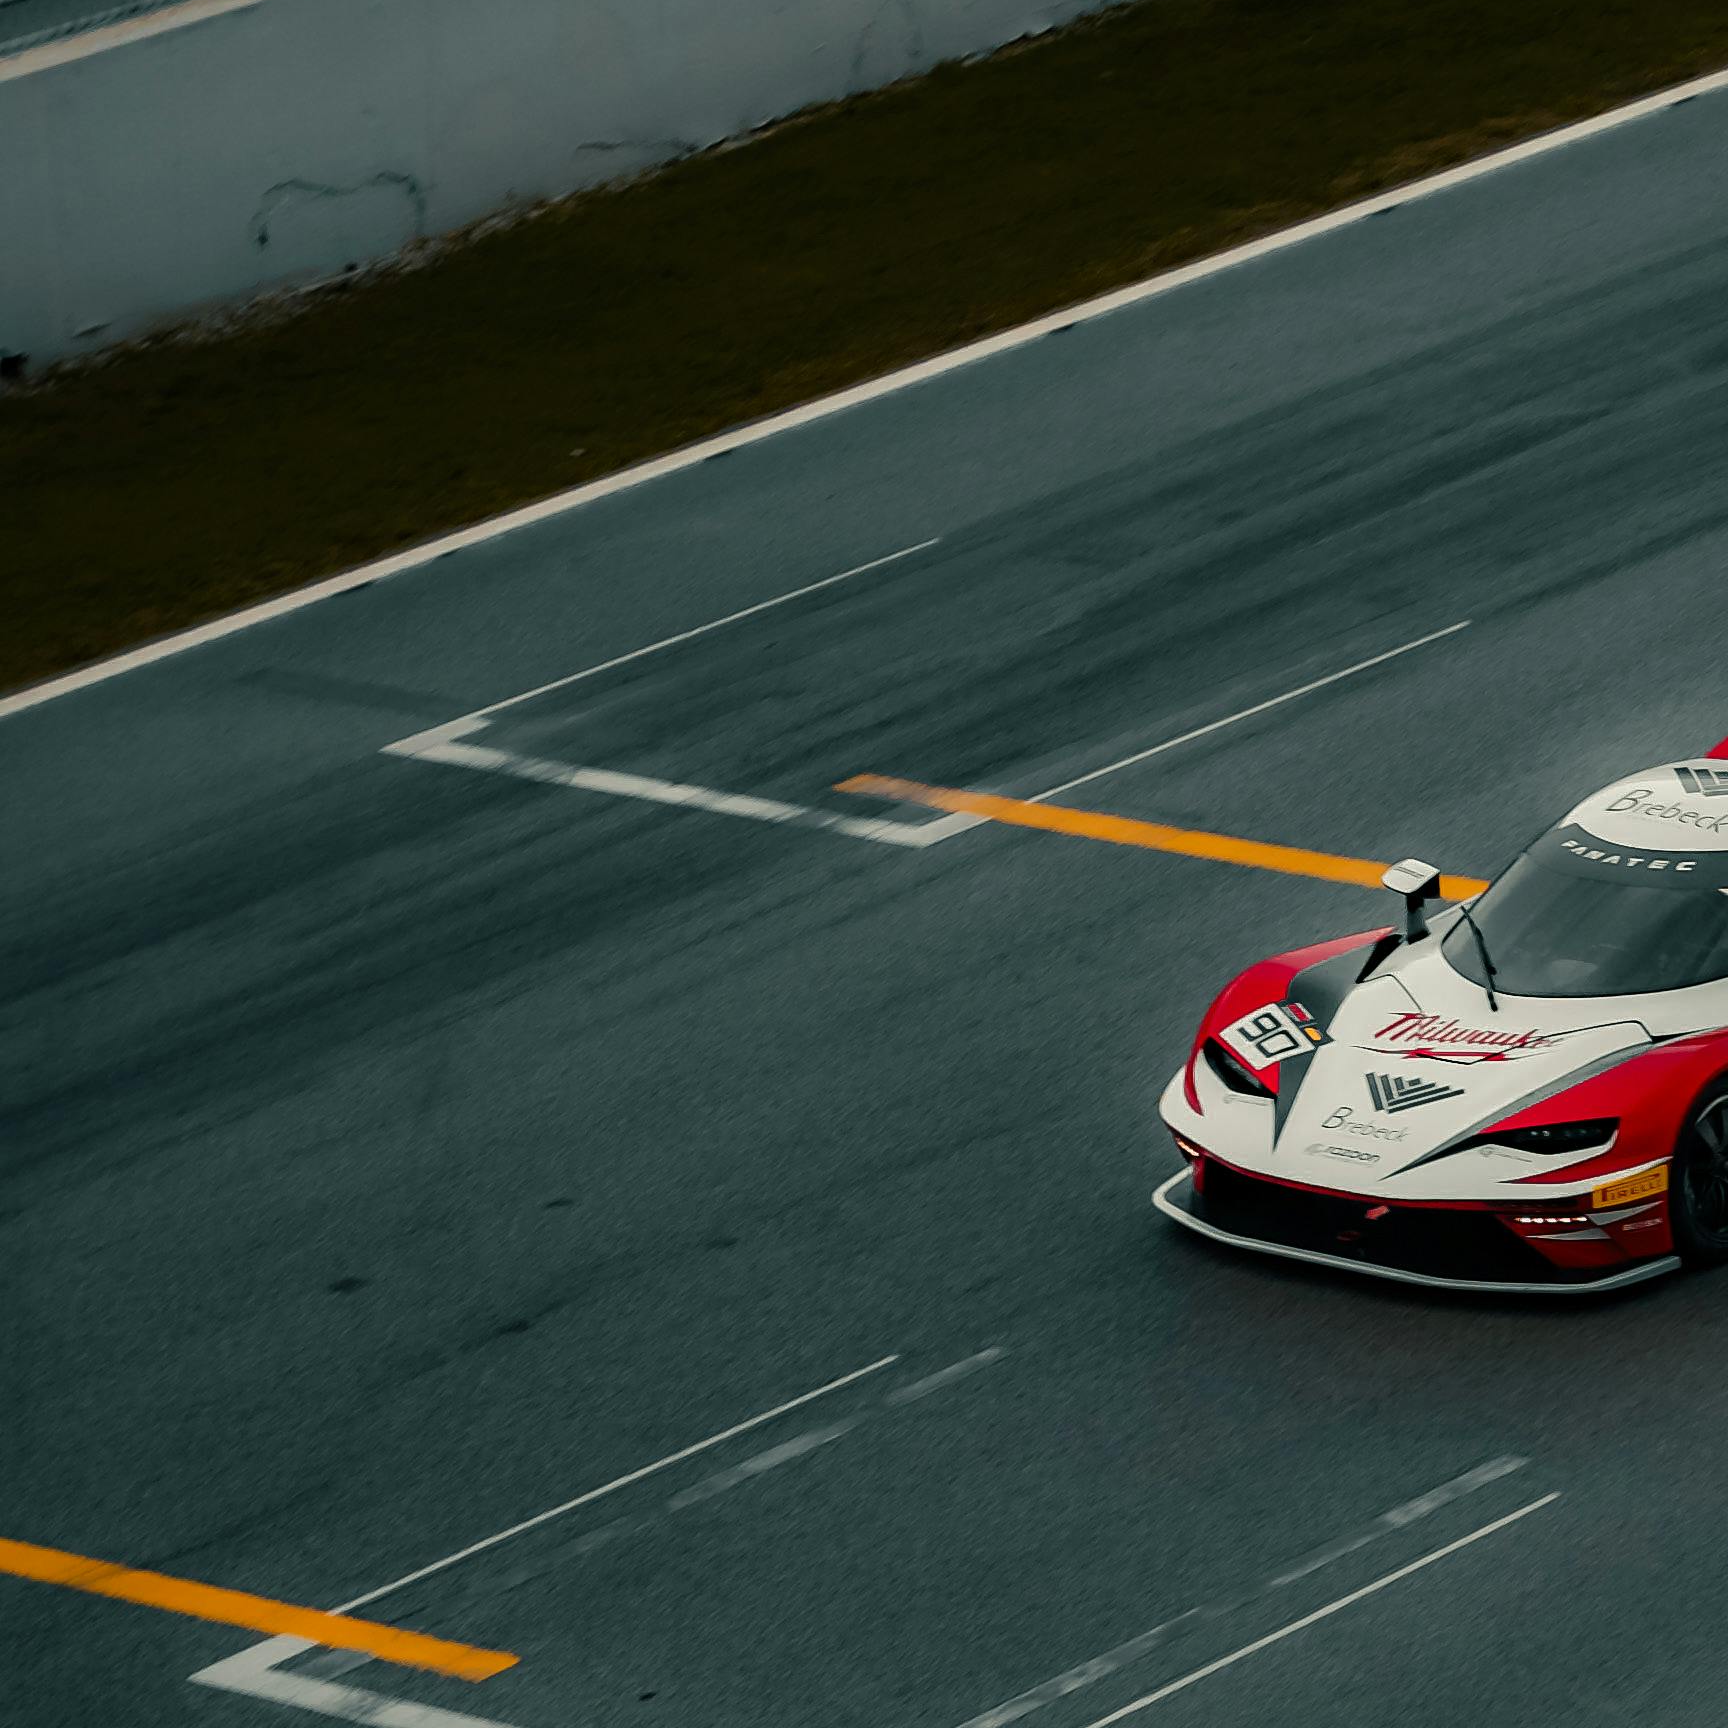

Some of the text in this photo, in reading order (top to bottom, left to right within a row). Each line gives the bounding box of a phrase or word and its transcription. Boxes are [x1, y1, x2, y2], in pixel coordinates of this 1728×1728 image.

[1560, 839, 1697, 872] FANATEC
[1238, 1013, 1300, 1058] 90
[1375, 1013, 1563, 1049] Milwaukee
[1321, 1106, 1410, 1141] Brebeck
[1601, 1172, 1662, 1202] PIRELLI
